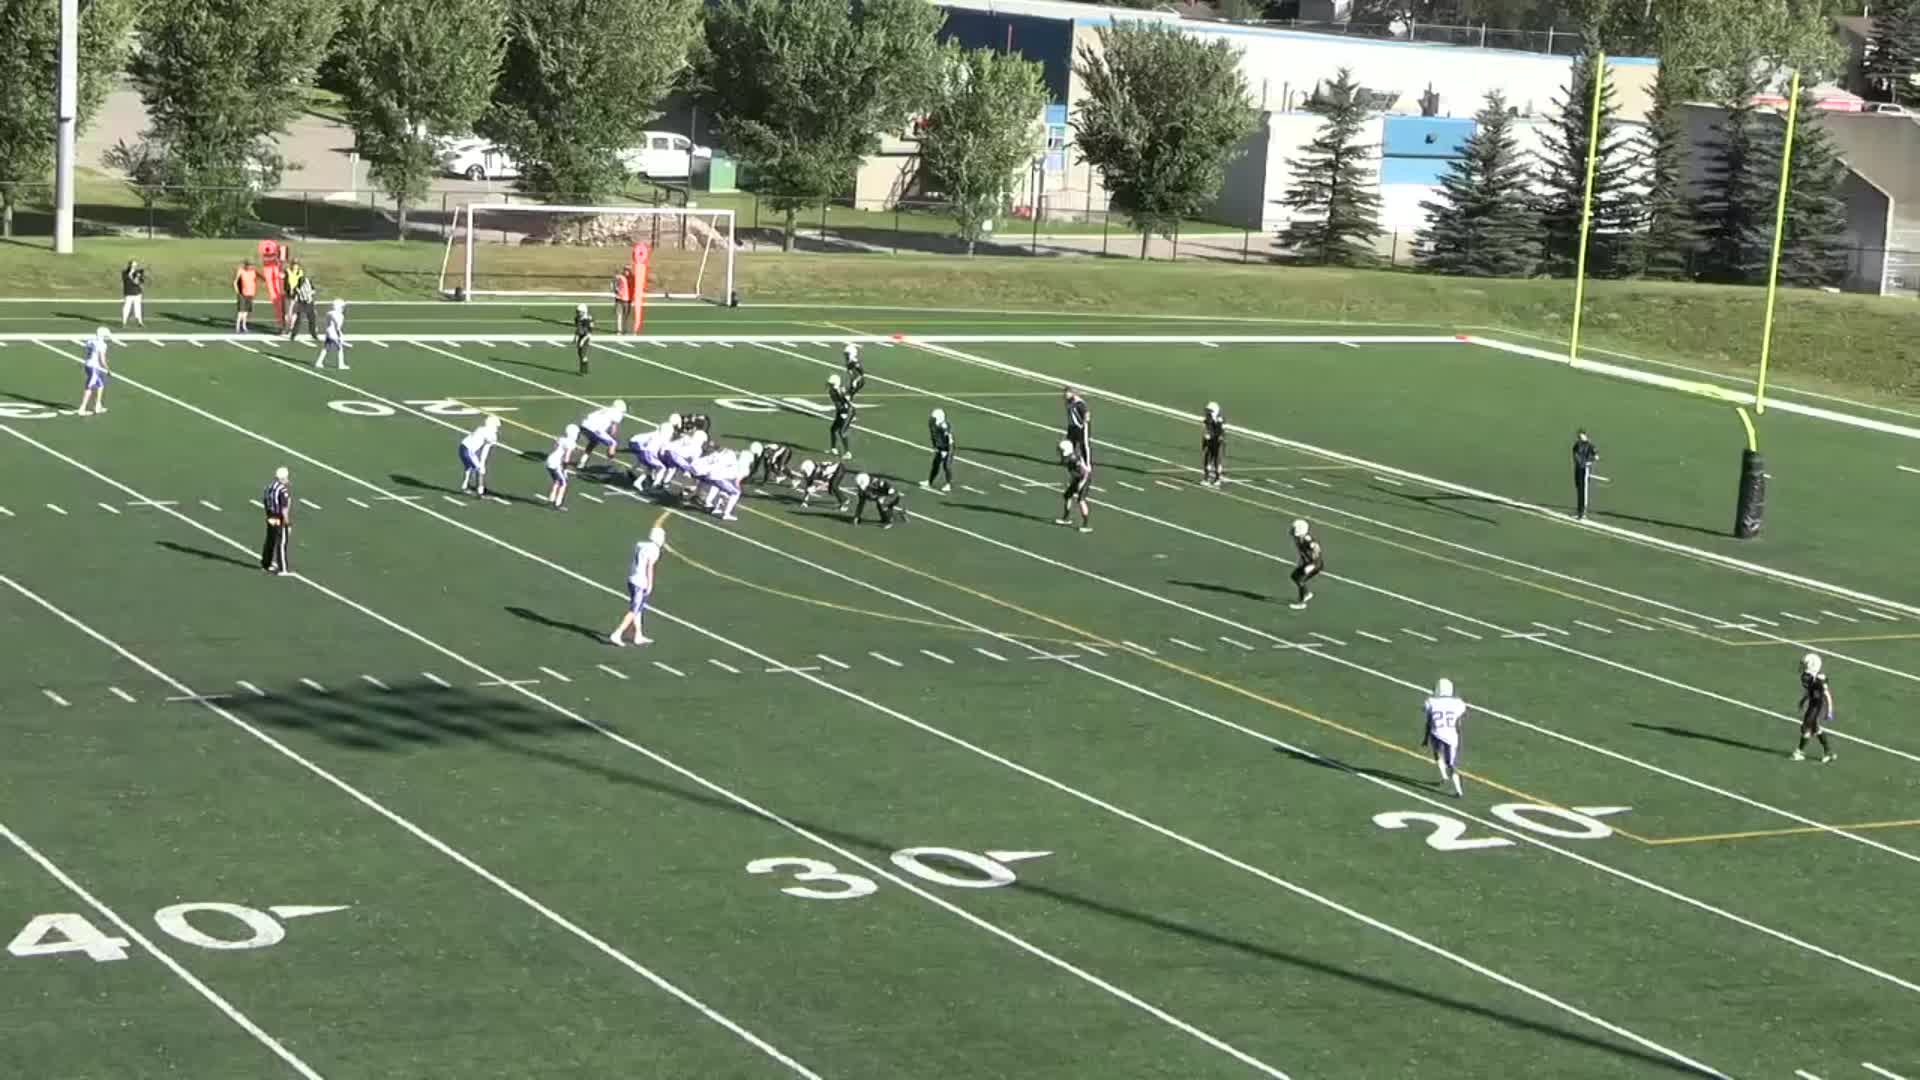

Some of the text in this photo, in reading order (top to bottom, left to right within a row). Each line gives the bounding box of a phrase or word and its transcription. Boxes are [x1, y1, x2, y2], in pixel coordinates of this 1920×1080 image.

[1372, 803, 1613, 851] 20
[746, 847, 1016, 899] 30
[7, 902, 286, 962] 40
